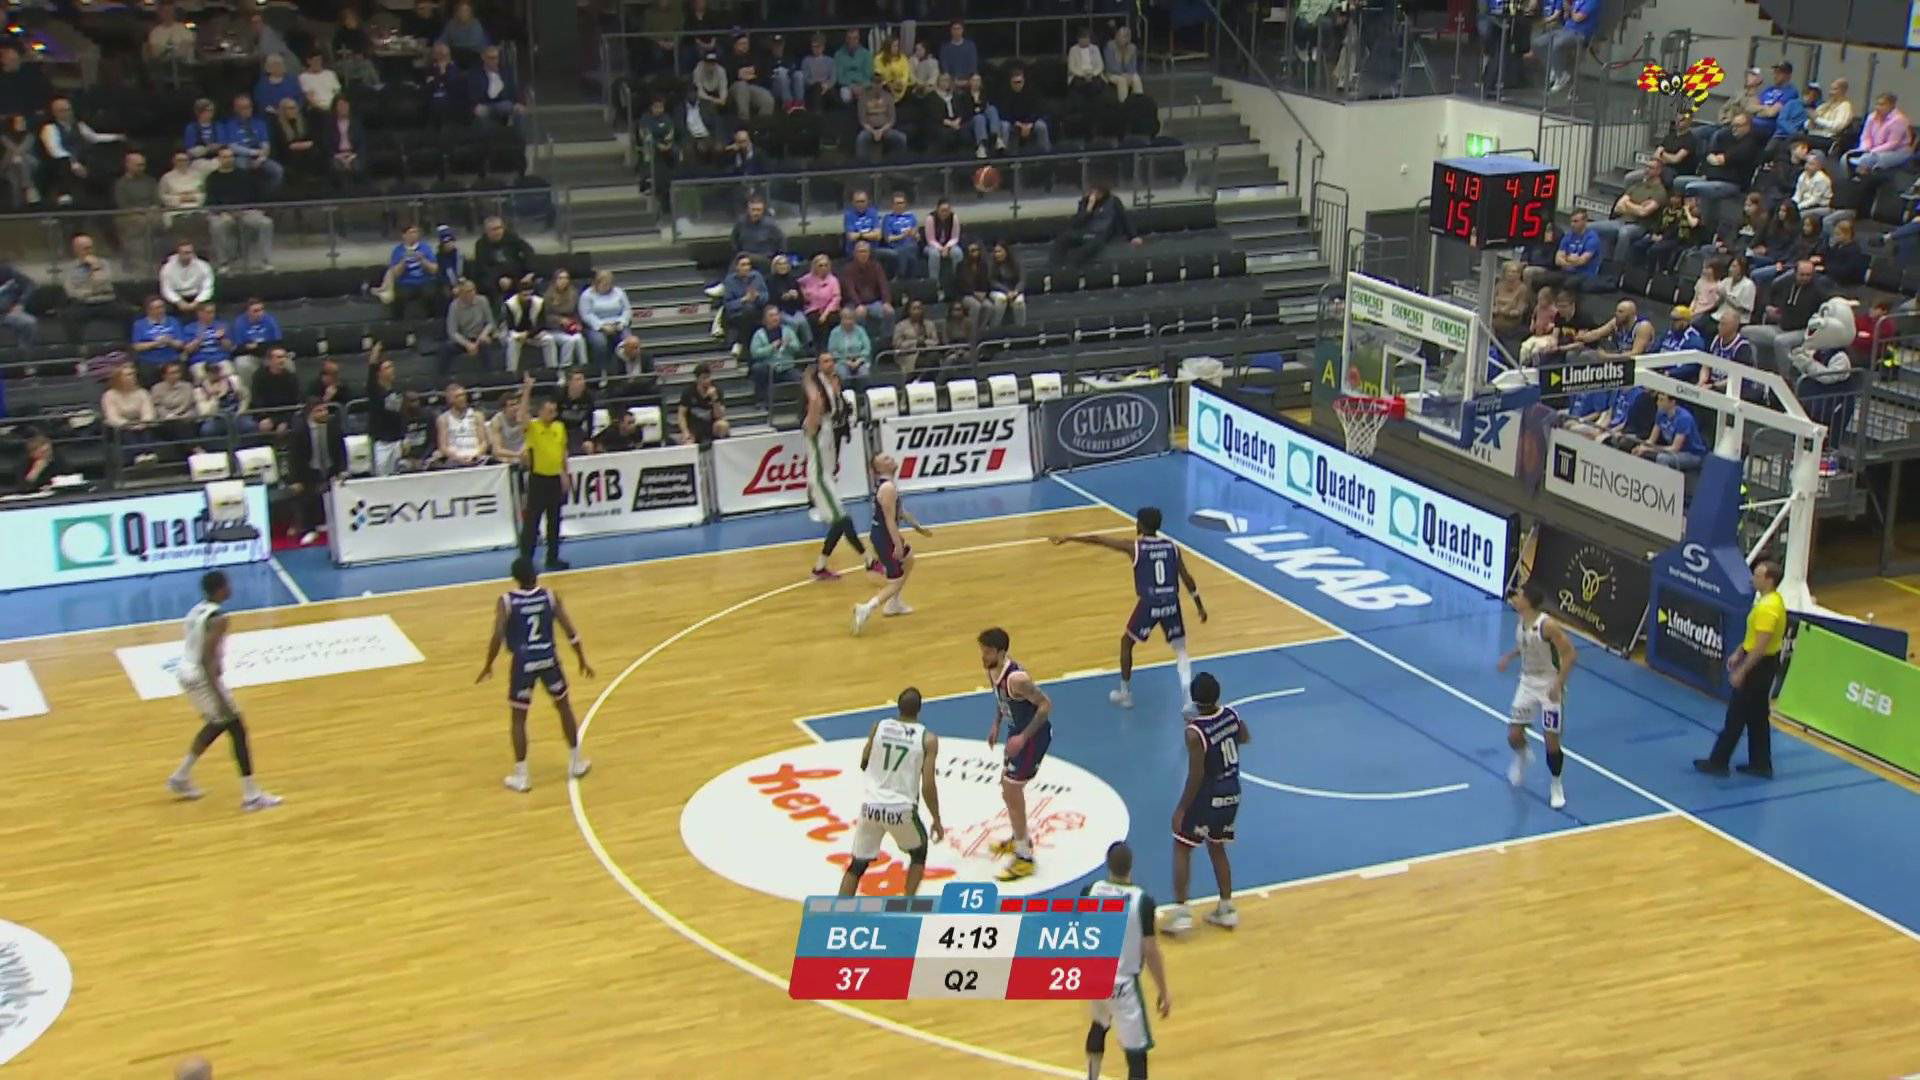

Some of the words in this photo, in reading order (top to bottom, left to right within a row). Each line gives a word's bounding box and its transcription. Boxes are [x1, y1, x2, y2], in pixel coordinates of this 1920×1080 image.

[1446, 200, 1471, 237] 15
[1508, 202, 1543, 237] 15
[1562, 362, 1624, 385] Lindroths
[896, 418, 1016, 450] TOMMYS
[1073, 400, 1144, 436] GUARD
[1223, 413, 1276, 470] Quadro
[918, 449, 987, 476] LAST
[1316, 454, 1376, 516] Quadro
[1580, 459, 1676, 515] TENGBOM
[367, 494, 498, 526] SKYLITE
[1422, 502, 1493, 568] Quadro
[1154, 559, 1166, 586] 0
[1224, 531, 1433, 610] LKAB
[526, 613, 543, 642] 2
[1667, 608, 1724, 650] Lindroths
[1846, 681, 1894, 716] SEB
[882, 742, 910, 772] 17
[1220, 736, 1239, 768] 10
